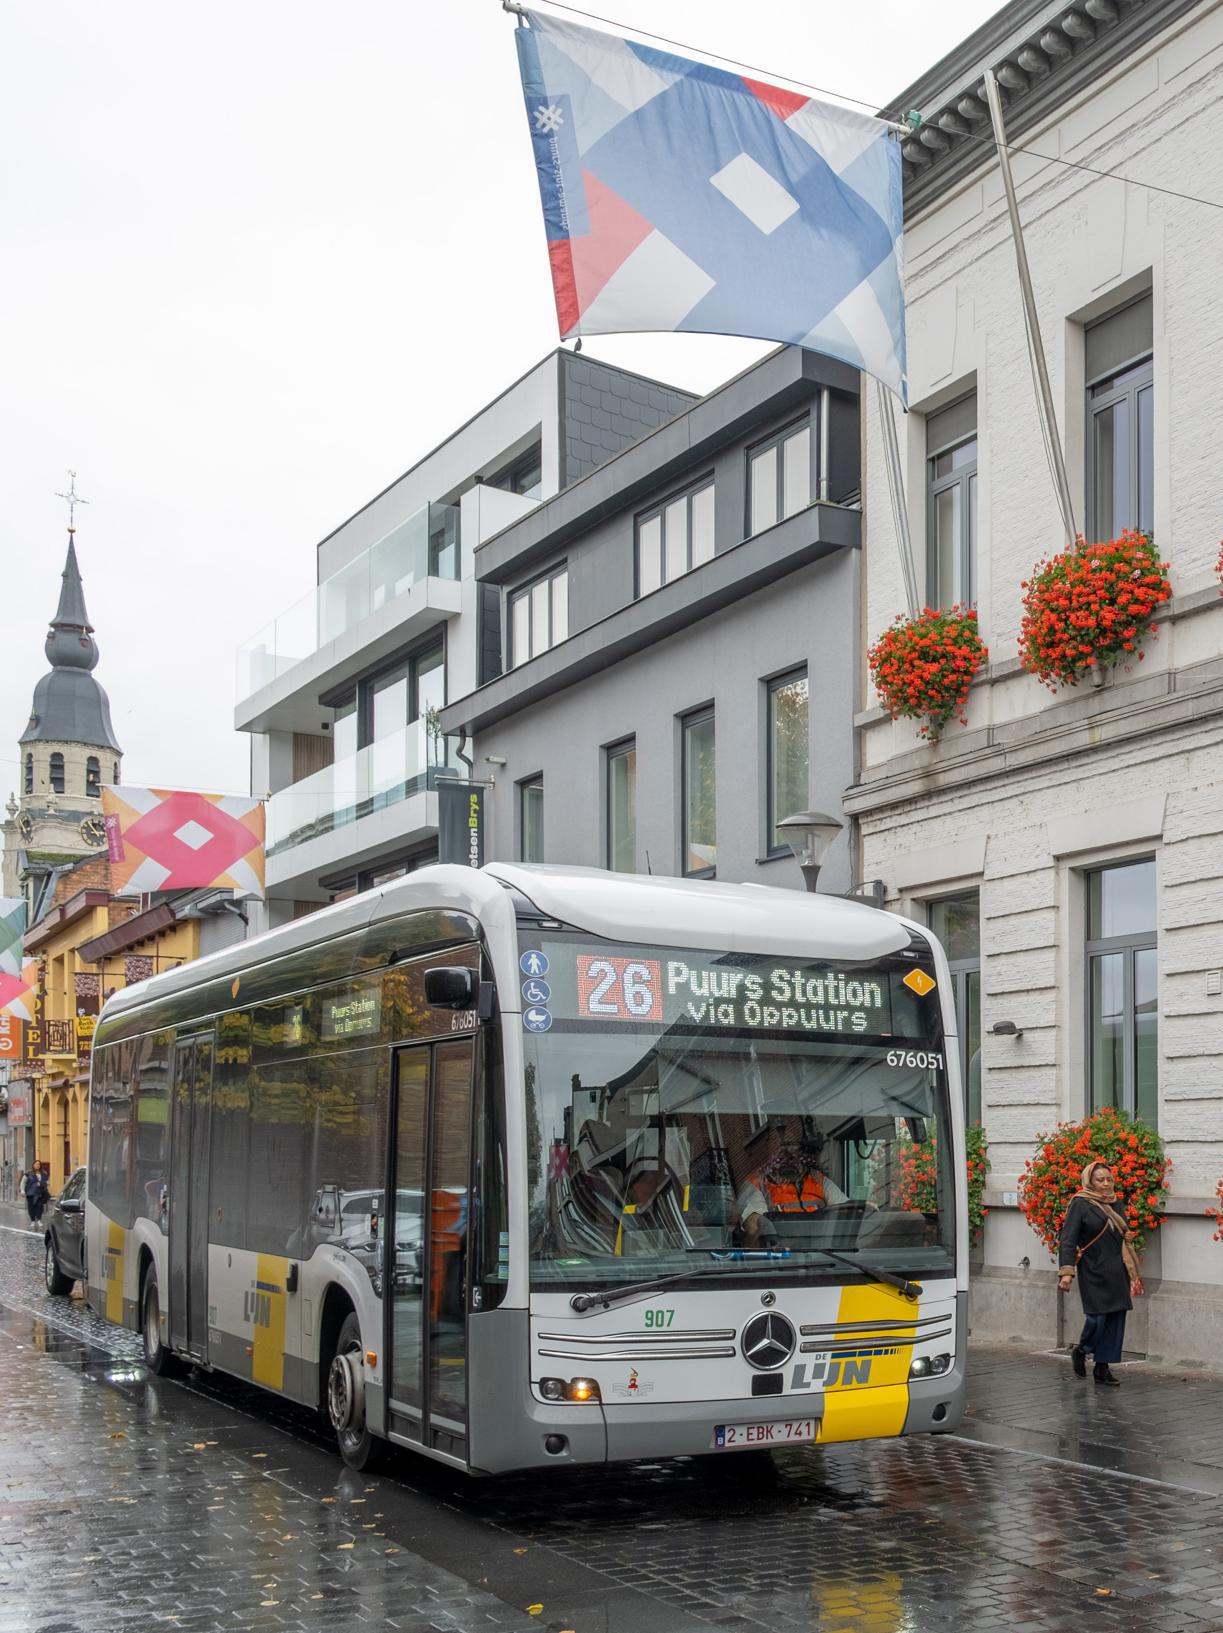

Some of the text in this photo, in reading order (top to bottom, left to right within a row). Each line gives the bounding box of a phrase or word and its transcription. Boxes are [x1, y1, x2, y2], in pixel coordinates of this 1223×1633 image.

[587, 961, 653, 1015] 26
[667, 961, 882, 1007] Puurs Station
[688, 999, 868, 1031] via Oppuurs
[886, 1050, 943, 1070] 676051
[645, 1309, 675, 1328] 907
[815, 1353, 827, 1361] DE
[790, 1359, 872, 1390] LIJN
[717, 1436, 724, 1445] B
